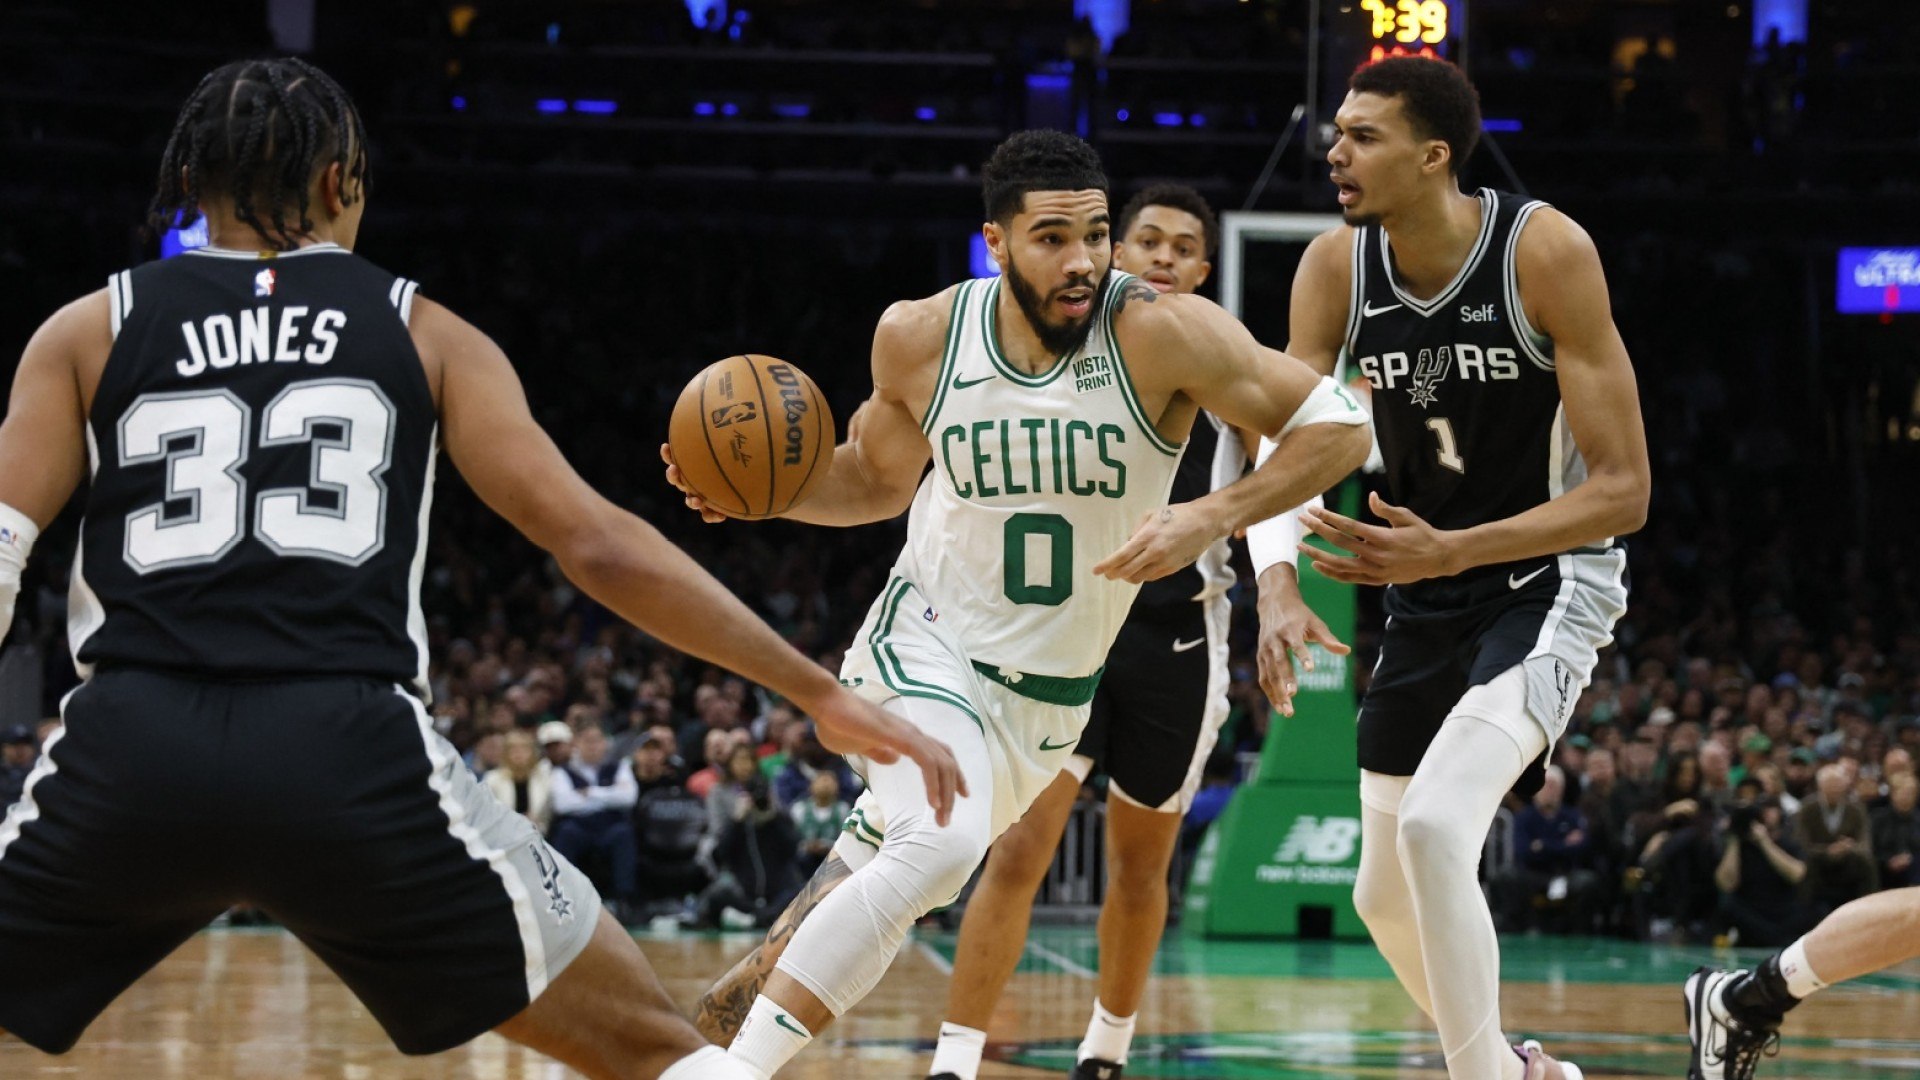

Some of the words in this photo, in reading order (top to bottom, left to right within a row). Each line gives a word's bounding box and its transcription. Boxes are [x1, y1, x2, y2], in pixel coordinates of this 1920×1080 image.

[1361, 0, 1447, 43] 7:39
[176, 306, 347, 377] JONES
[1072, 355, 1110, 379] VISTA
[1076, 372, 1111, 392] PRINT
[767, 364, 807, 467] Wilson
[1425, 417, 1465, 475] 1
[117, 378, 397, 575] 33
[942, 418, 1126, 498] CELTICS
[1003, 513, 1073, 606] 0
[1273, 815, 1361, 863] NB
